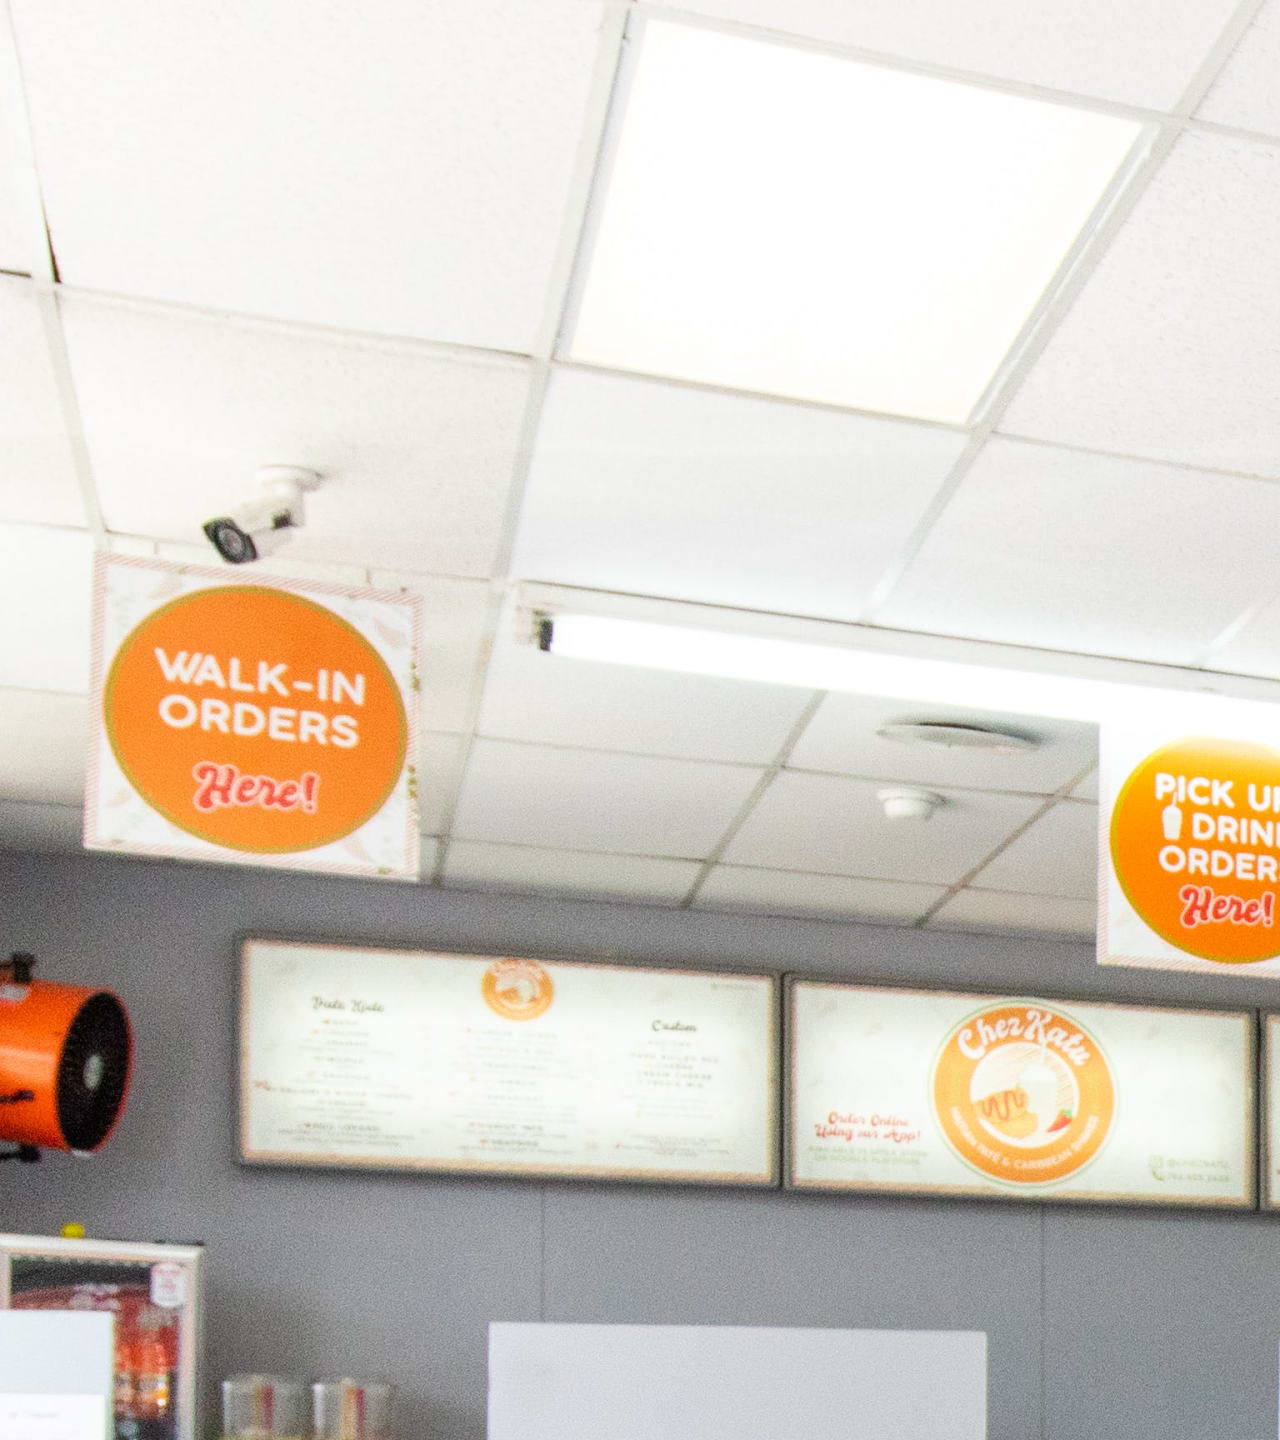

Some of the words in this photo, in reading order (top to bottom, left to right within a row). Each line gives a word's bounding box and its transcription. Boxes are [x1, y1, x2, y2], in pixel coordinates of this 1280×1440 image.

[154, 646, 365, 706] WALK-IN
[158, 694, 360, 749] ORDERS
[193, 761, 320, 814] Here!
[1155, 772, 1235, 808] PICK
[1179, 884, 1275, 928] Here!
[957, 1015, 1025, 1060] Chez
[1023, 1009, 1092, 1066] Katu
